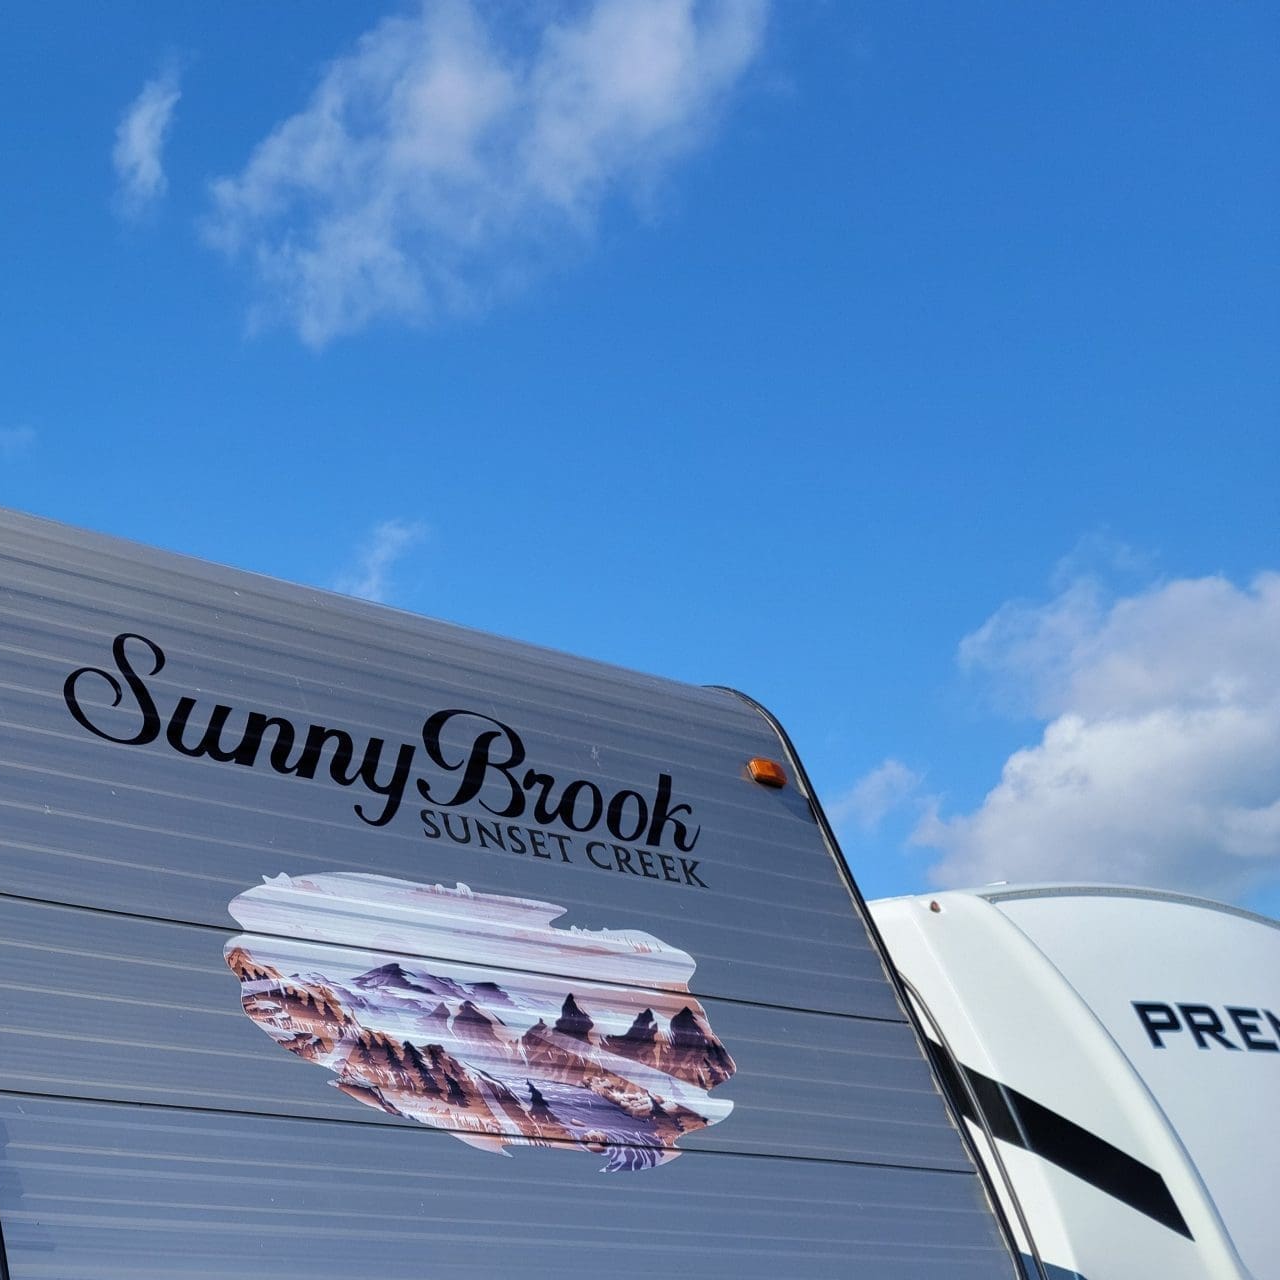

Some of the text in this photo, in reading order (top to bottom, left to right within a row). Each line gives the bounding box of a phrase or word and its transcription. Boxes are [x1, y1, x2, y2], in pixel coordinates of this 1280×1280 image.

[62, 632, 701, 852] SunnyBrook
[419, 808, 710, 889] SUNSET CREEK
[1130, 1001, 1280, 1053] PRE
